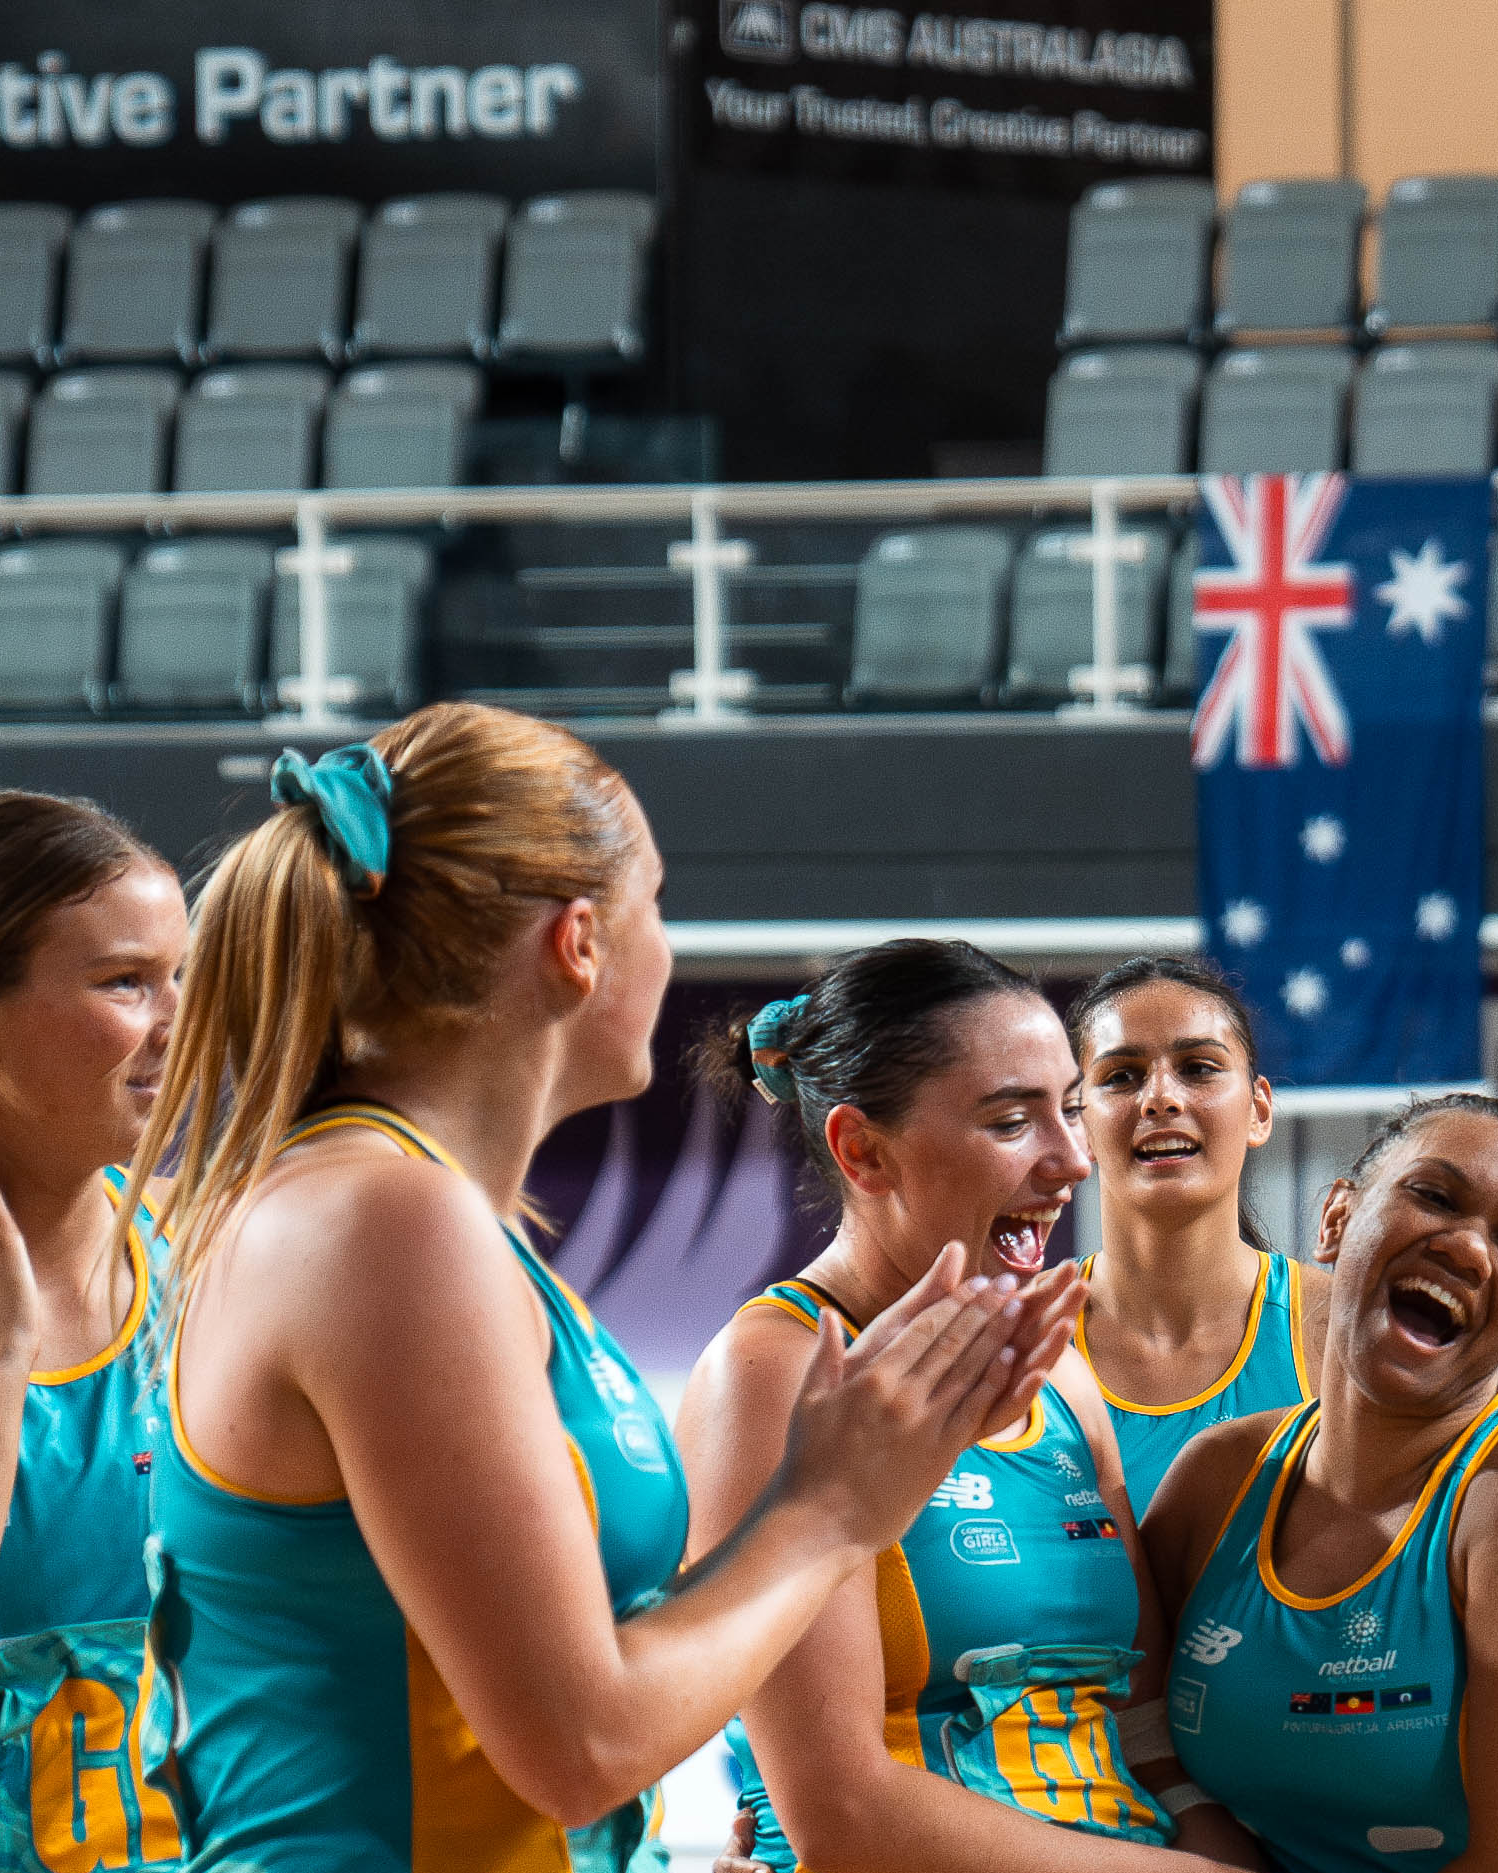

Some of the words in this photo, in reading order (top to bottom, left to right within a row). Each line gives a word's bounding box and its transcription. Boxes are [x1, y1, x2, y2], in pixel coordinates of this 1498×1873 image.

[192, 45, 579, 145] Partner
[1064, 1489, 1104, 1508] netba
[962, 1534, 1008, 1550] GIRLS
[1317, 1649, 1398, 1677] netball
